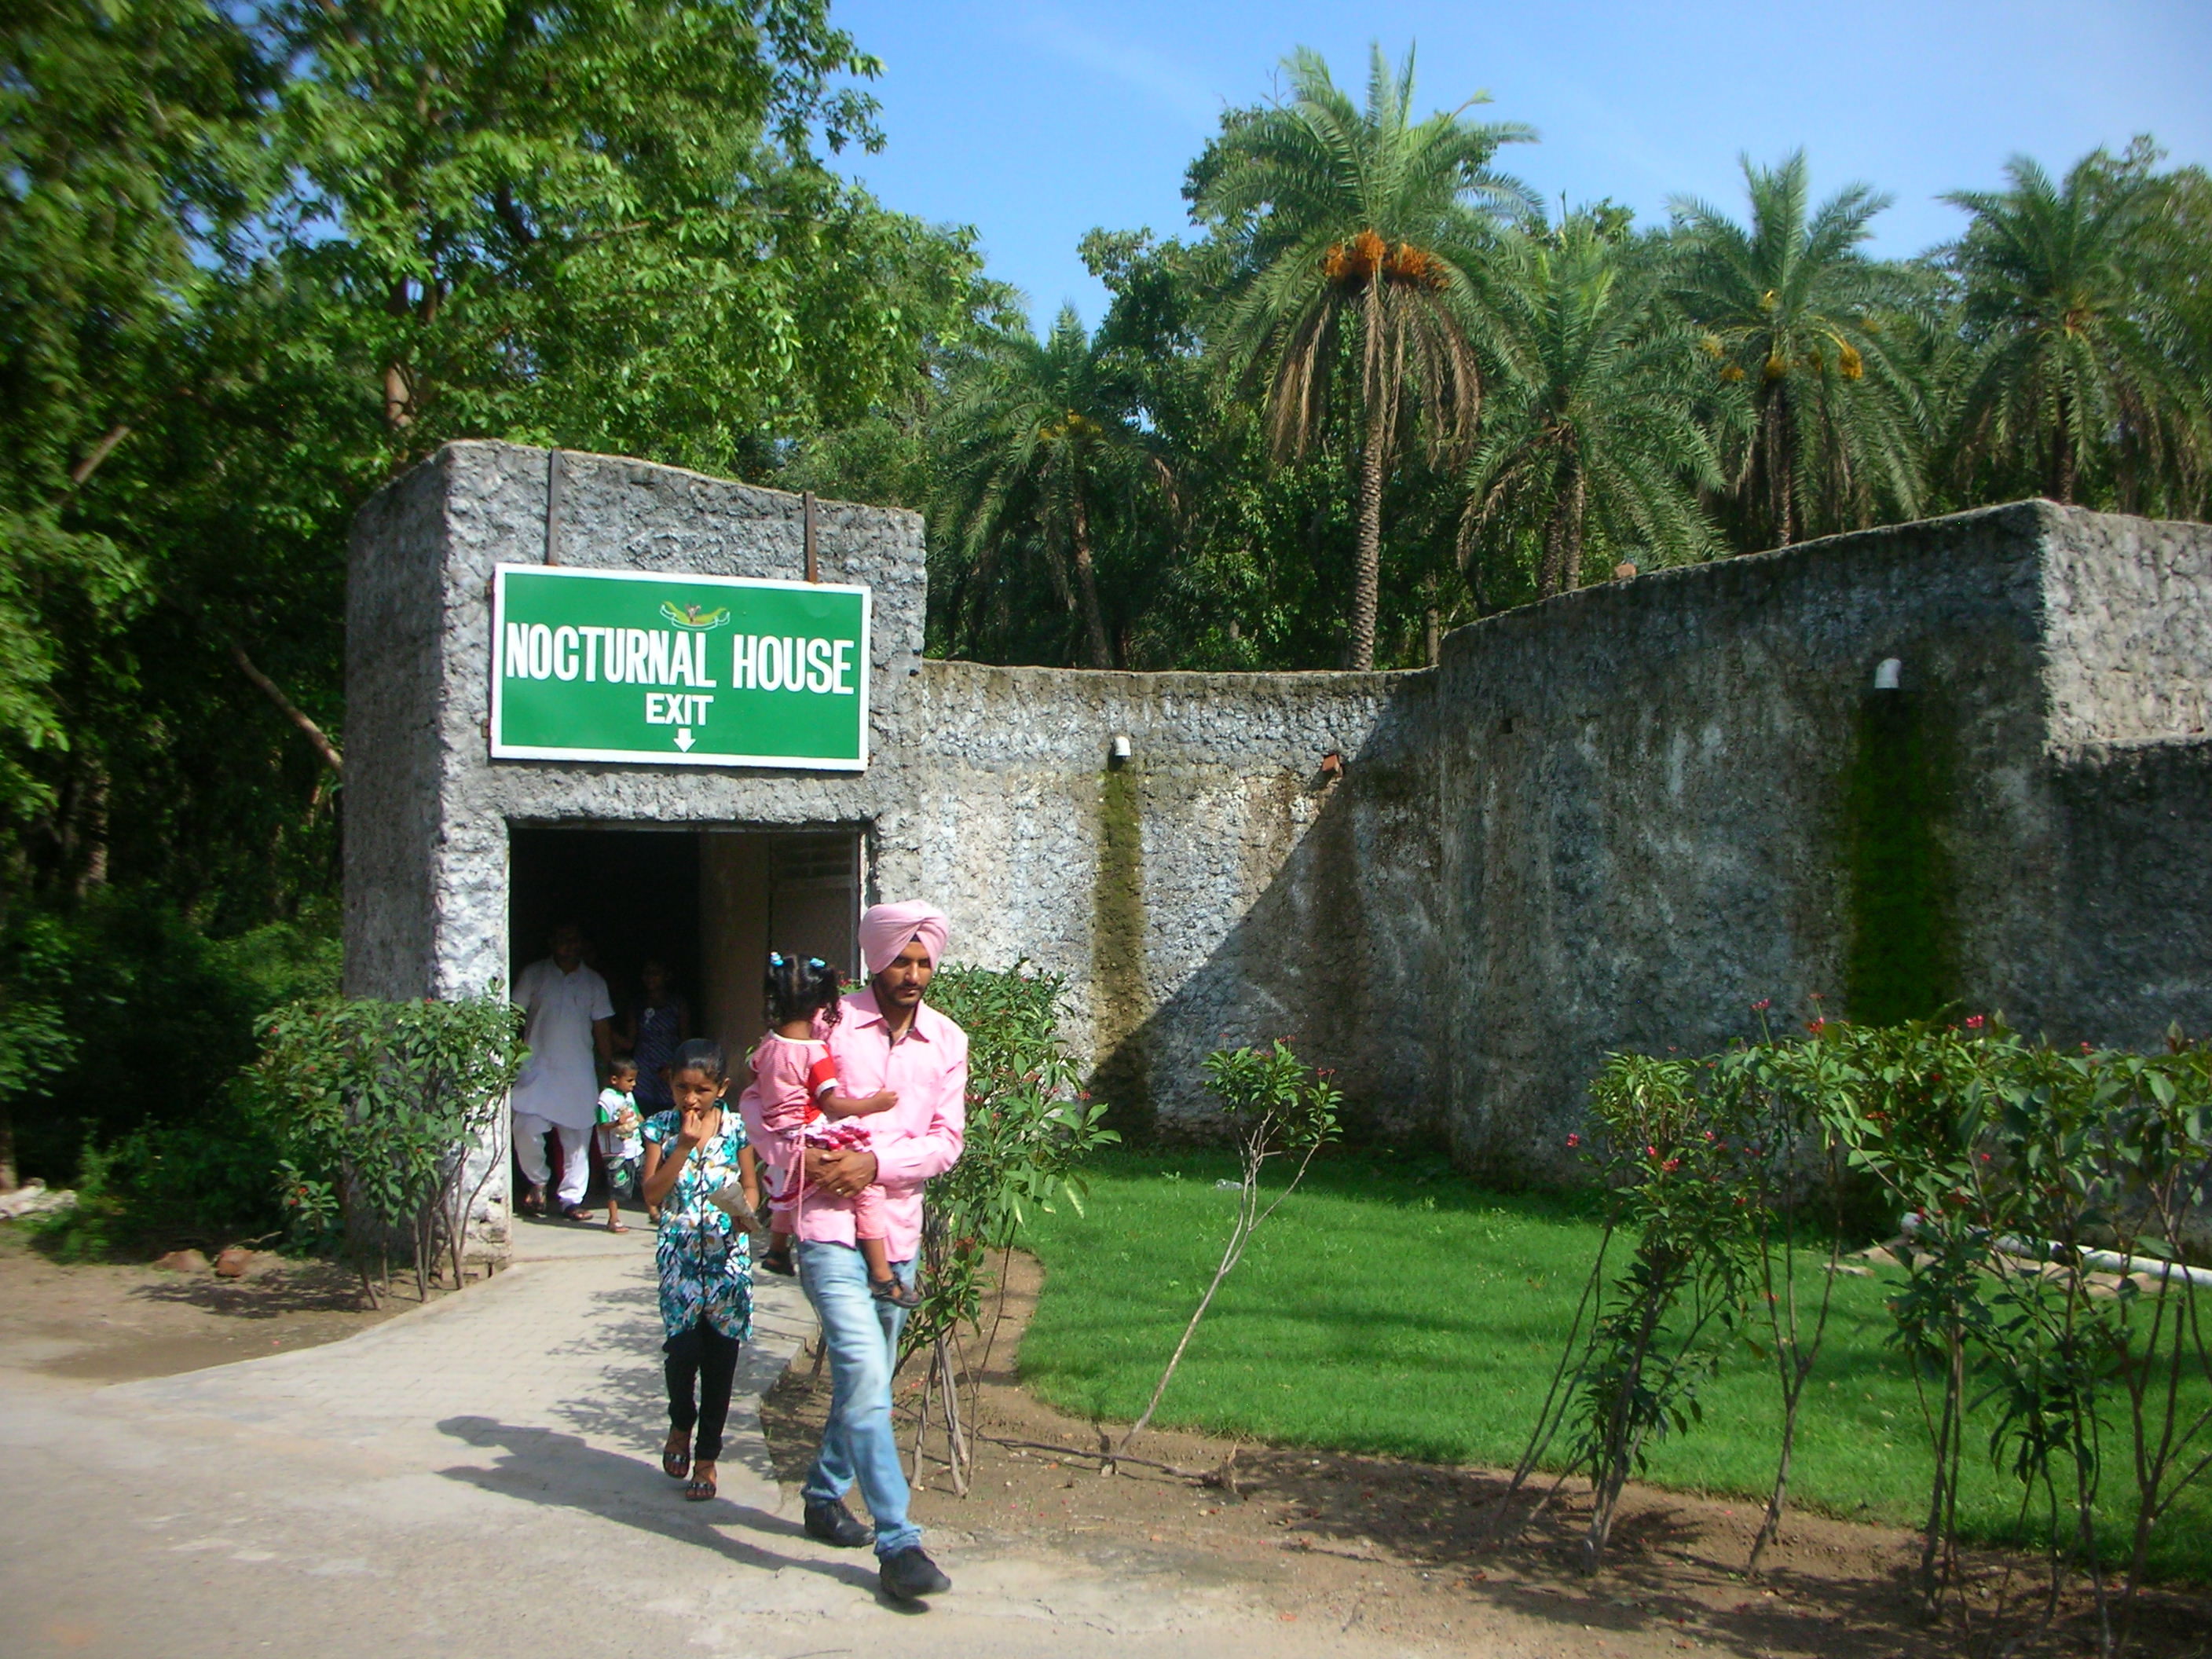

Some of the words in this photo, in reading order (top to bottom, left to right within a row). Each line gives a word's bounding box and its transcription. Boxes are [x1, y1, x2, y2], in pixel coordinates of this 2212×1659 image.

[506, 622, 716, 688] NOCTURNAL
[732, 634, 855, 695] HOUSE
[646, 692, 714, 726] EXIT
